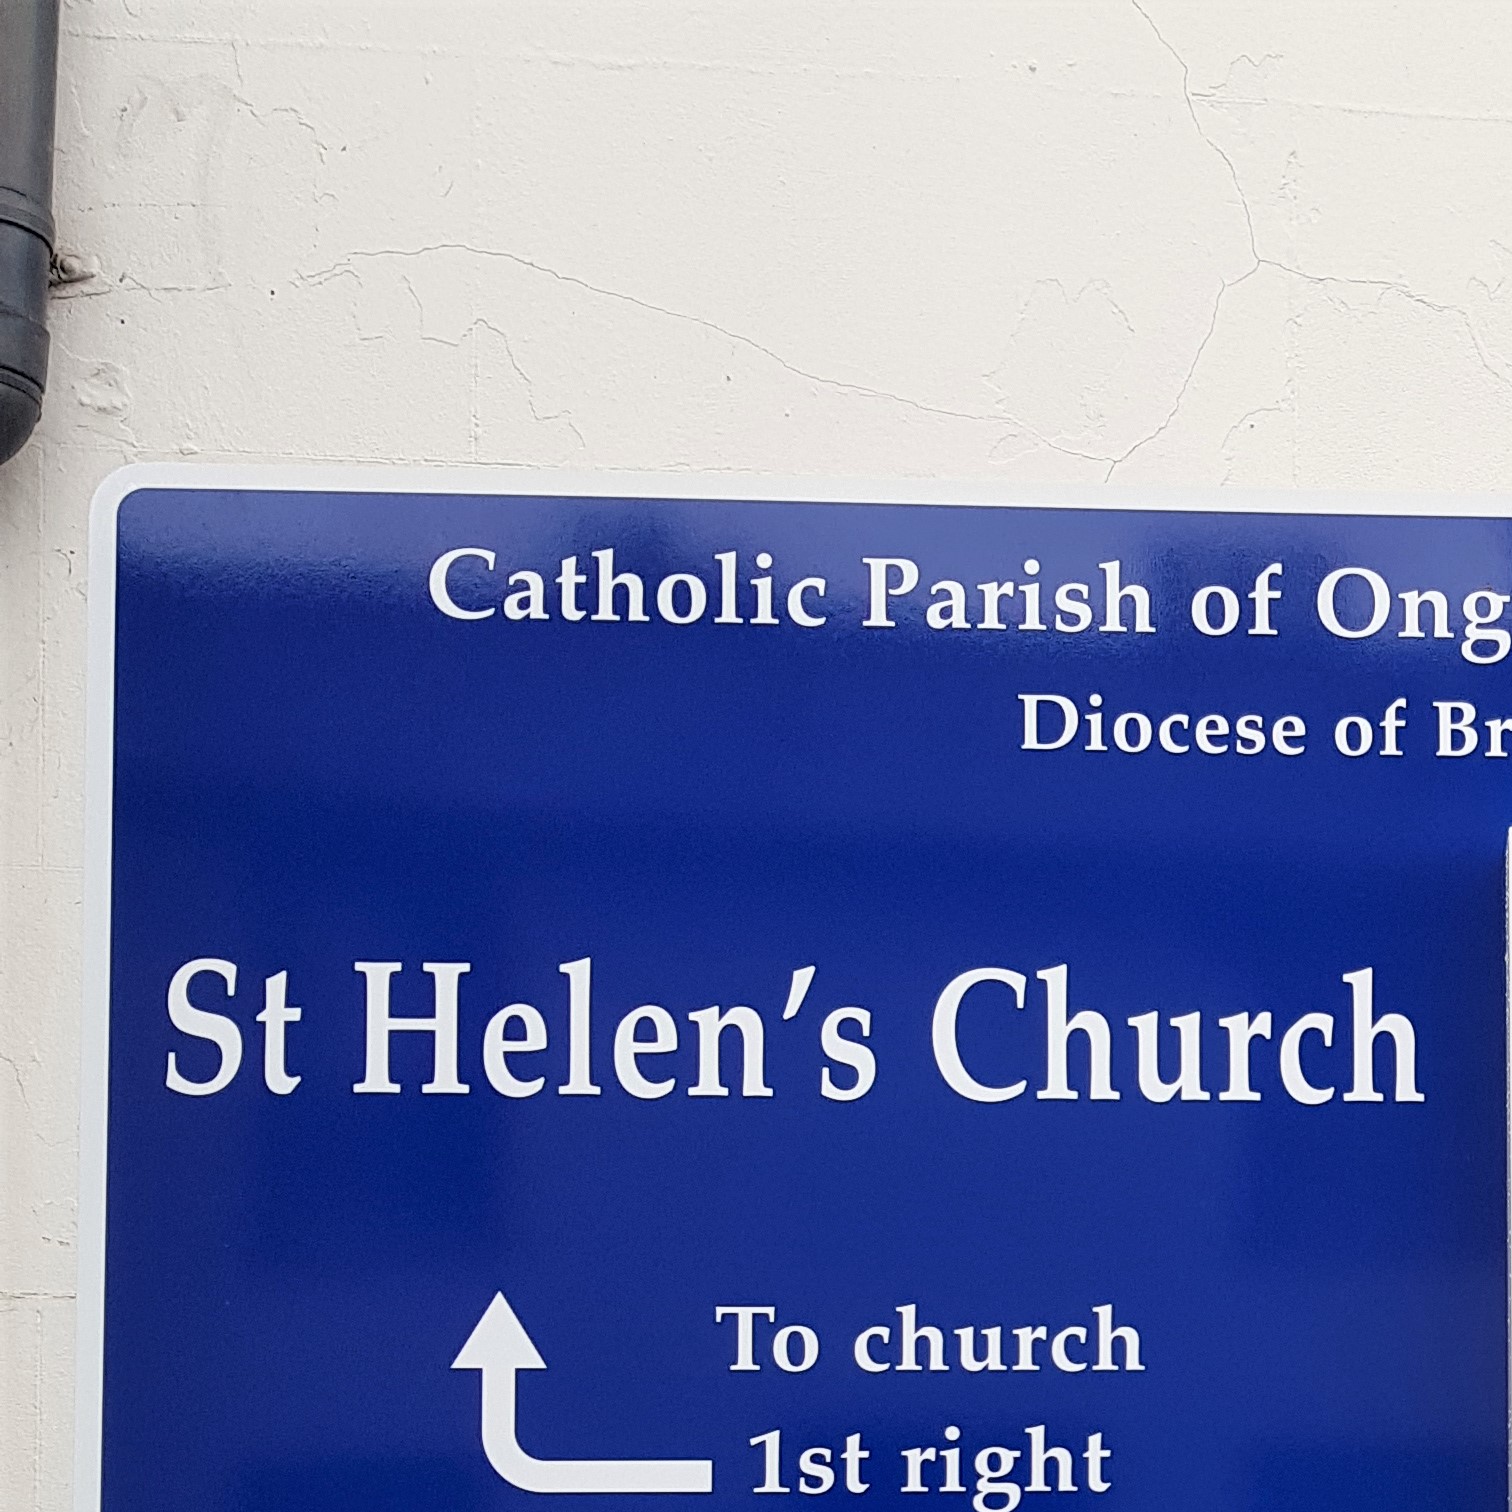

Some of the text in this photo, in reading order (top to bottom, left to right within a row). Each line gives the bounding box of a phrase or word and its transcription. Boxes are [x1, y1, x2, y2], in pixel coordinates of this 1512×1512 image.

[429, 548, 826, 626] Catholic
[862, 558, 1156, 632] Parish
[1192, 563, 1282, 635] of
[1018, 694, 1305, 755] Diocese
[1335, 698, 1406, 756] of
[166, 957, 1424, 1104] St Helen’s Church
[716, 1304, 1145, 1372] To church
[750, 1430, 869, 1494] 1st
